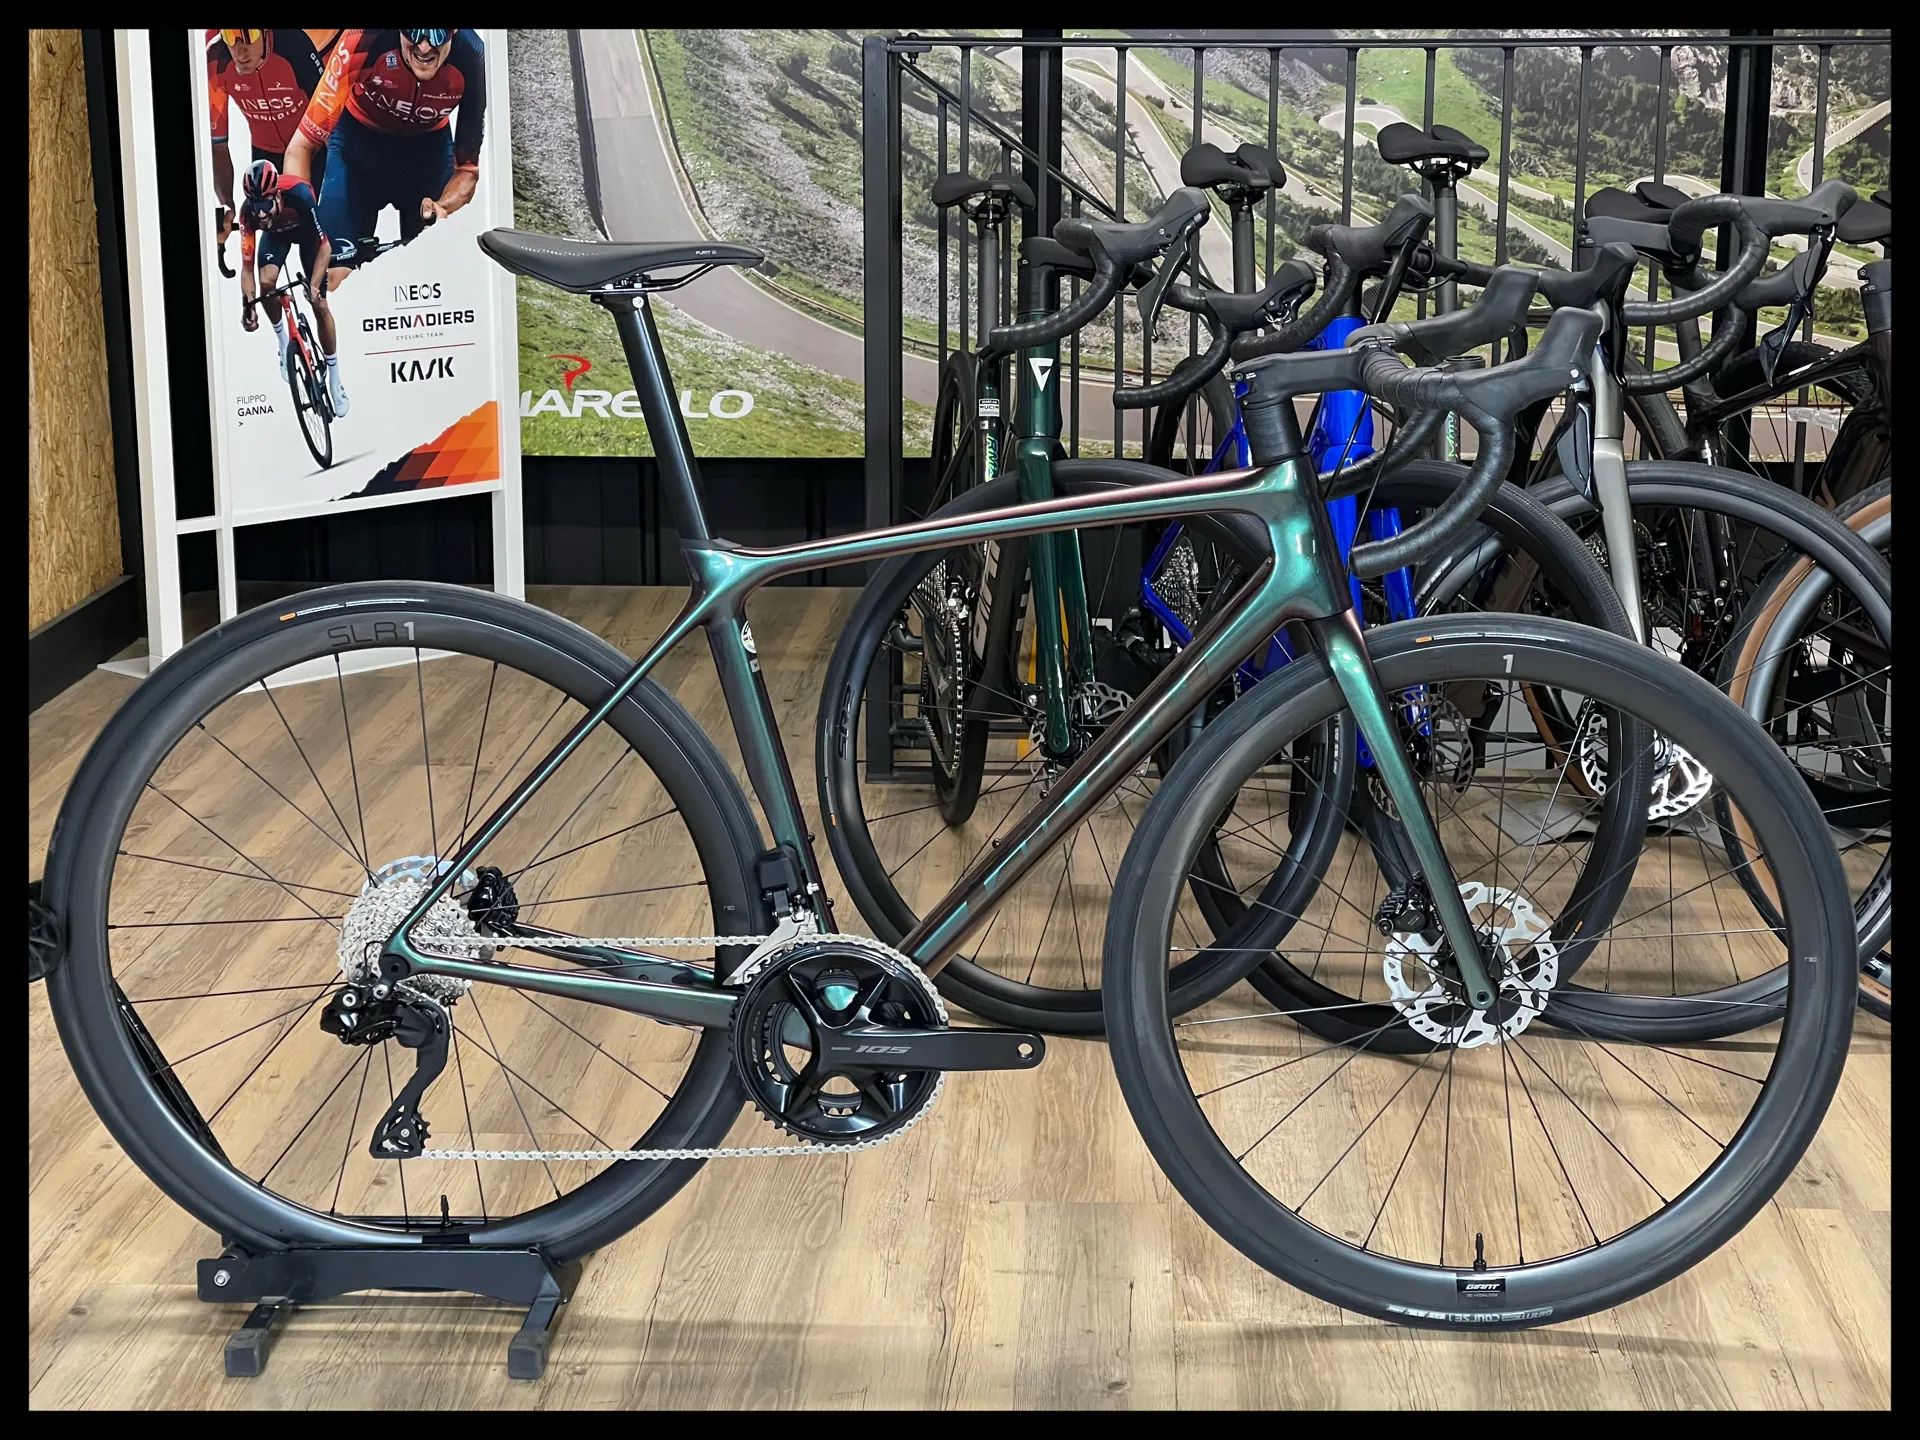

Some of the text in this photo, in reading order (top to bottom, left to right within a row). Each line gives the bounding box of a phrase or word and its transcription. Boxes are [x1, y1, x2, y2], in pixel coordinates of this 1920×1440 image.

[241, 96, 294, 110] INEOS
[394, 282, 441, 302] INEOS
[363, 310, 475, 332] GRENADIERS
[396, 333, 424, 341] CYCLING
[391, 356, 455, 384] KASK
[236, 394, 267, 405] FILIPPO
[237, 405, 274, 417] GANNA
[327, 621, 415, 647] SLR 1
[1502, 654, 1514, 674] 1
